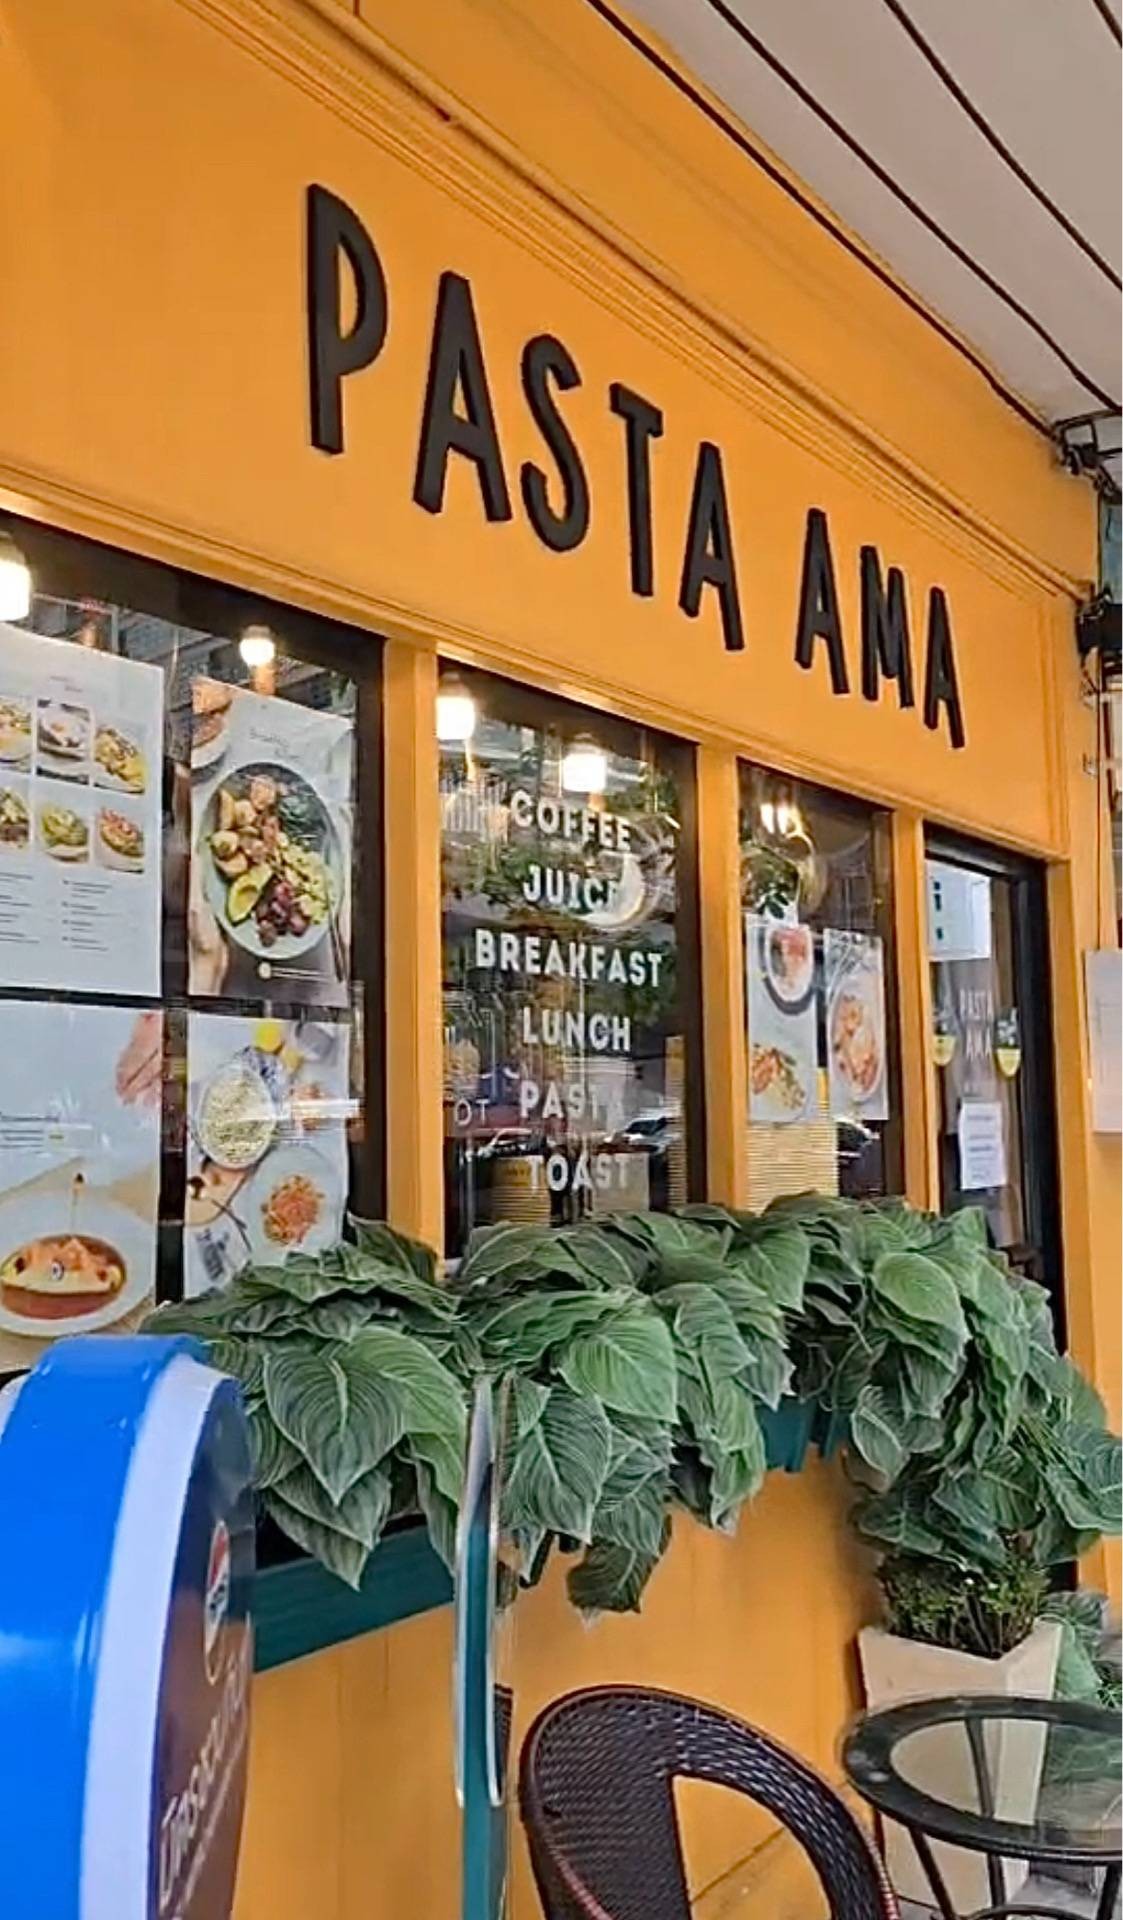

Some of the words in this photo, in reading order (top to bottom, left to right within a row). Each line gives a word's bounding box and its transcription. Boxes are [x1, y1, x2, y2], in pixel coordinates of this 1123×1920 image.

[306, 182, 745, 652] PASTA
[794, 507, 966, 750] AMA
[509, 789, 632, 852] COFFEE
[474, 927, 663, 987] BREAKFAST
[522, 1006, 632, 1053] LUNCH
[526, 1152, 629, 1192] TOAST
